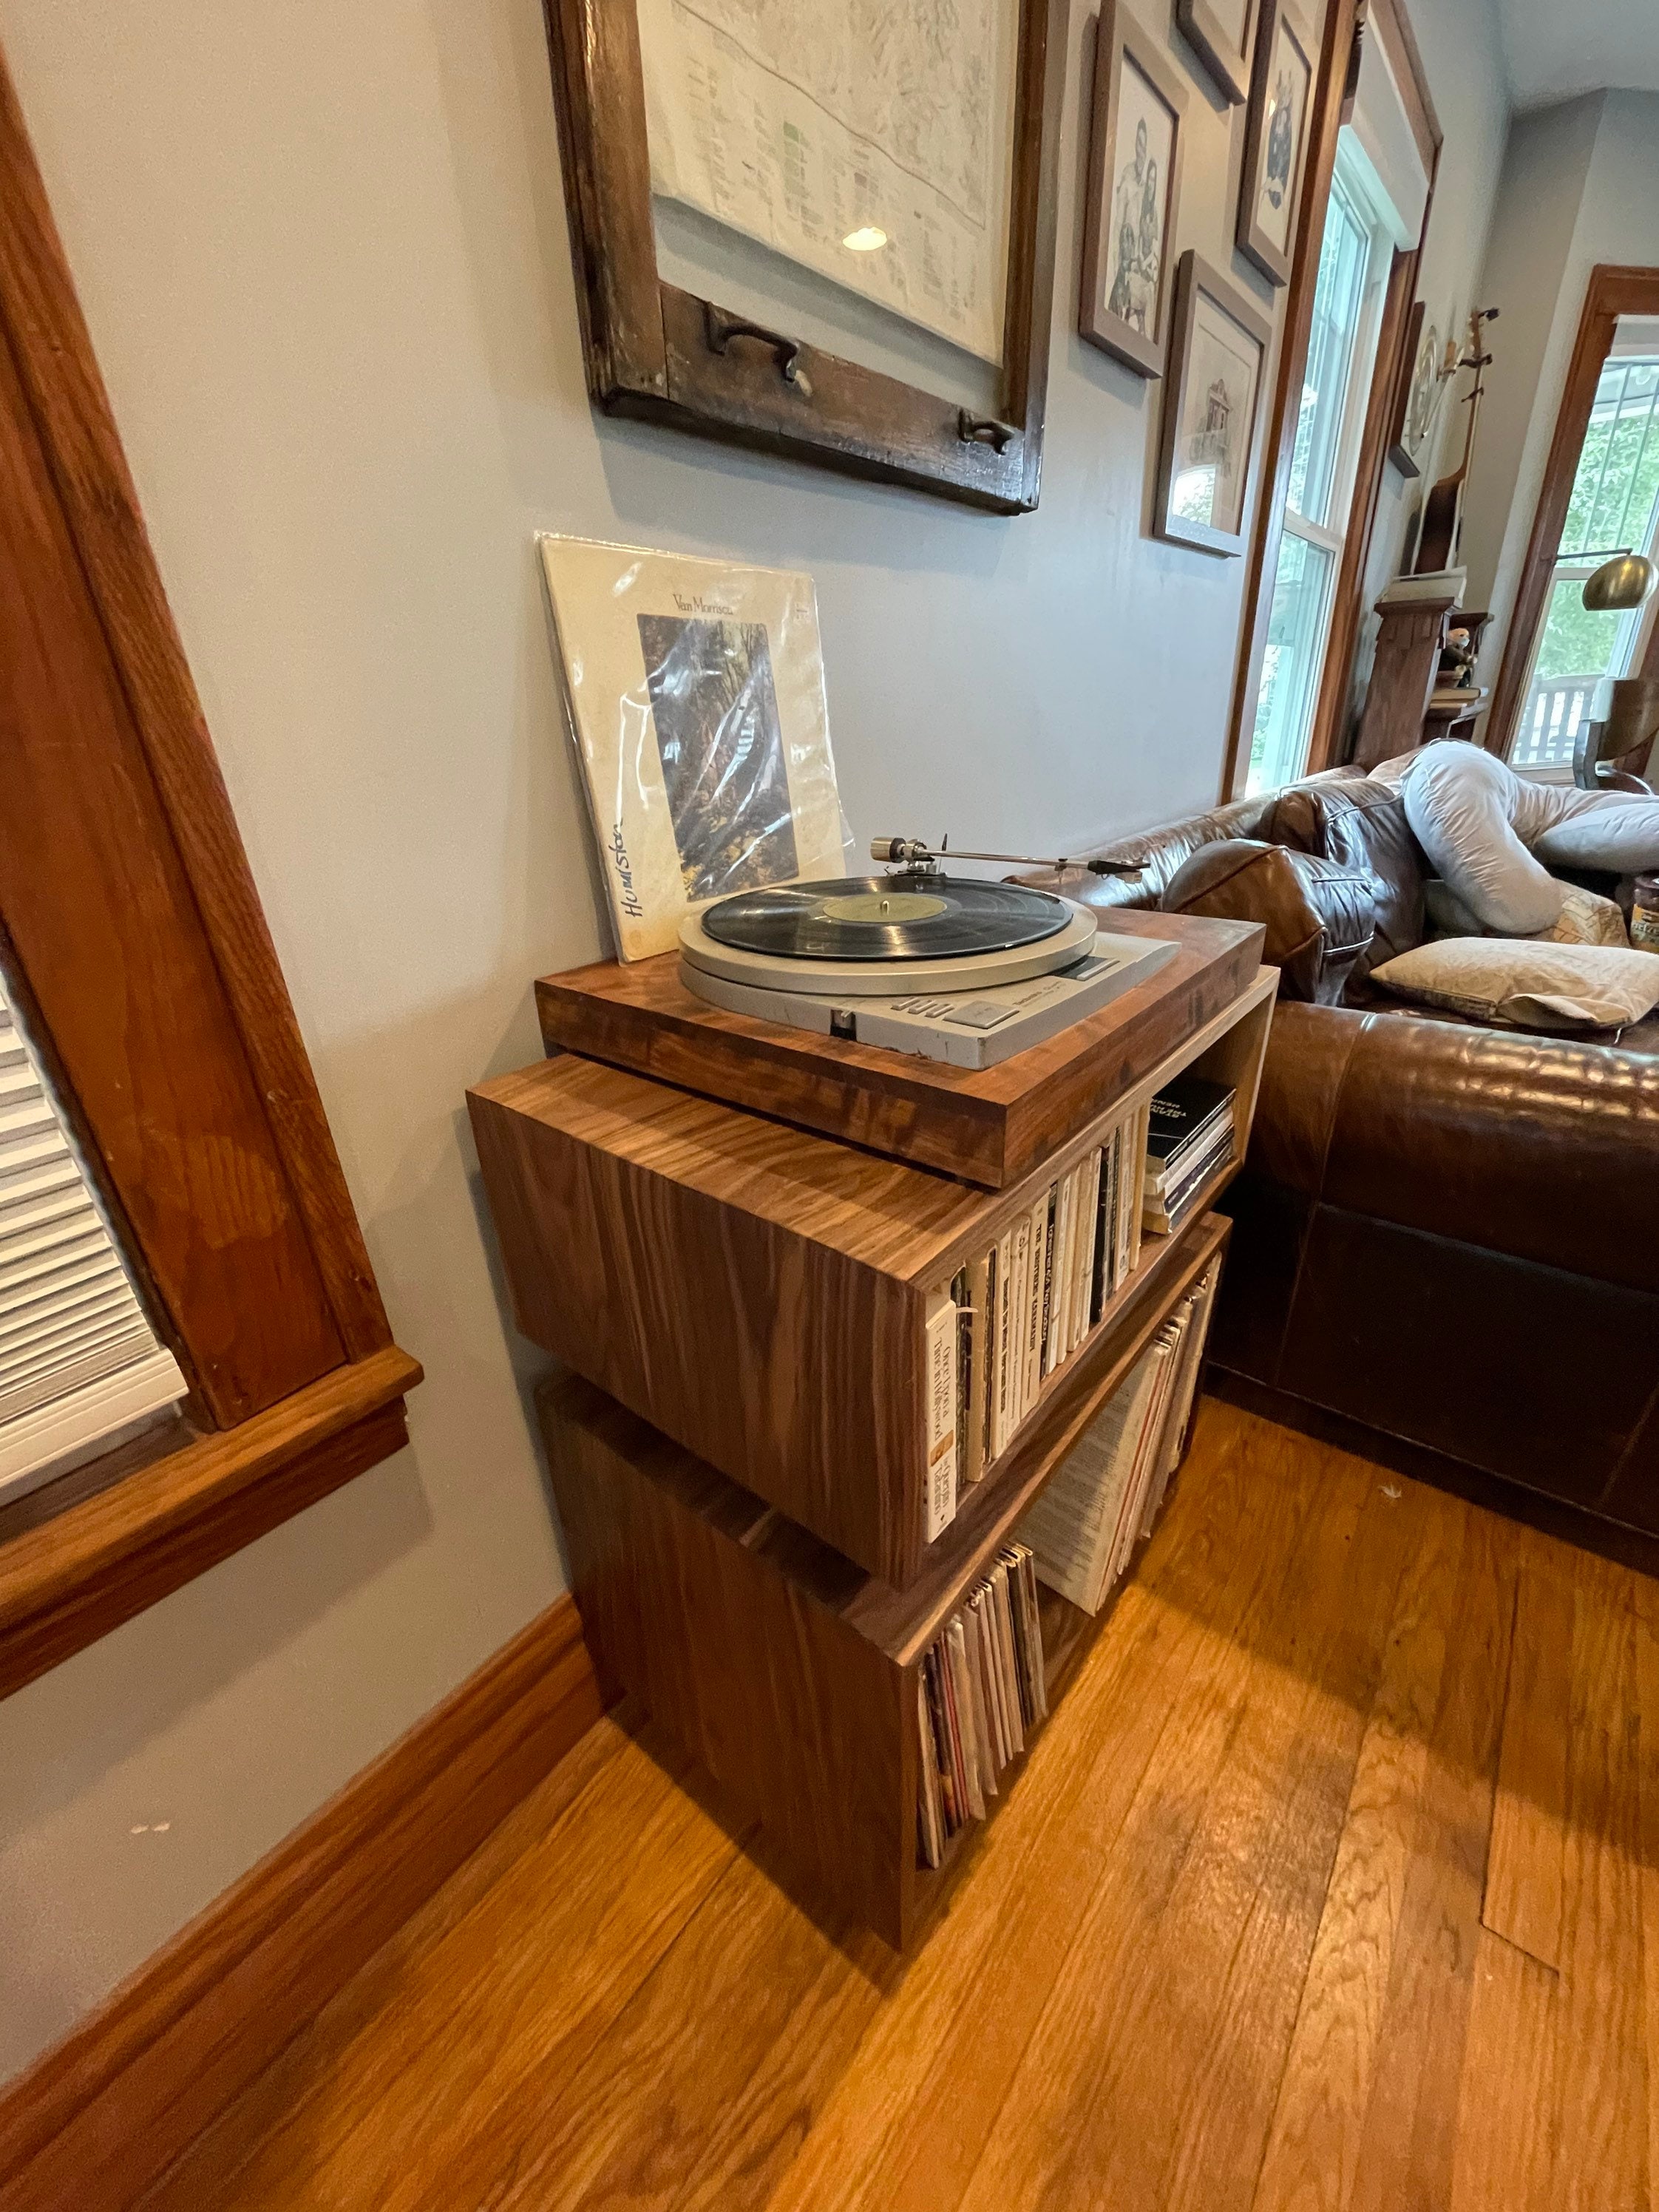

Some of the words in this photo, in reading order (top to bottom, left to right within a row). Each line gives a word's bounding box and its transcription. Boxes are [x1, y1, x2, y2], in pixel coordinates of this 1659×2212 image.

[673, 594, 693, 612] Van
[693, 596, 733, 615] Morrison
[934, 1337, 942, 1369] Time
[943, 1346, 951, 1377] Once
[941, 1376, 951, 1409] Upon
[933, 1380, 943, 1441] Hollywood
